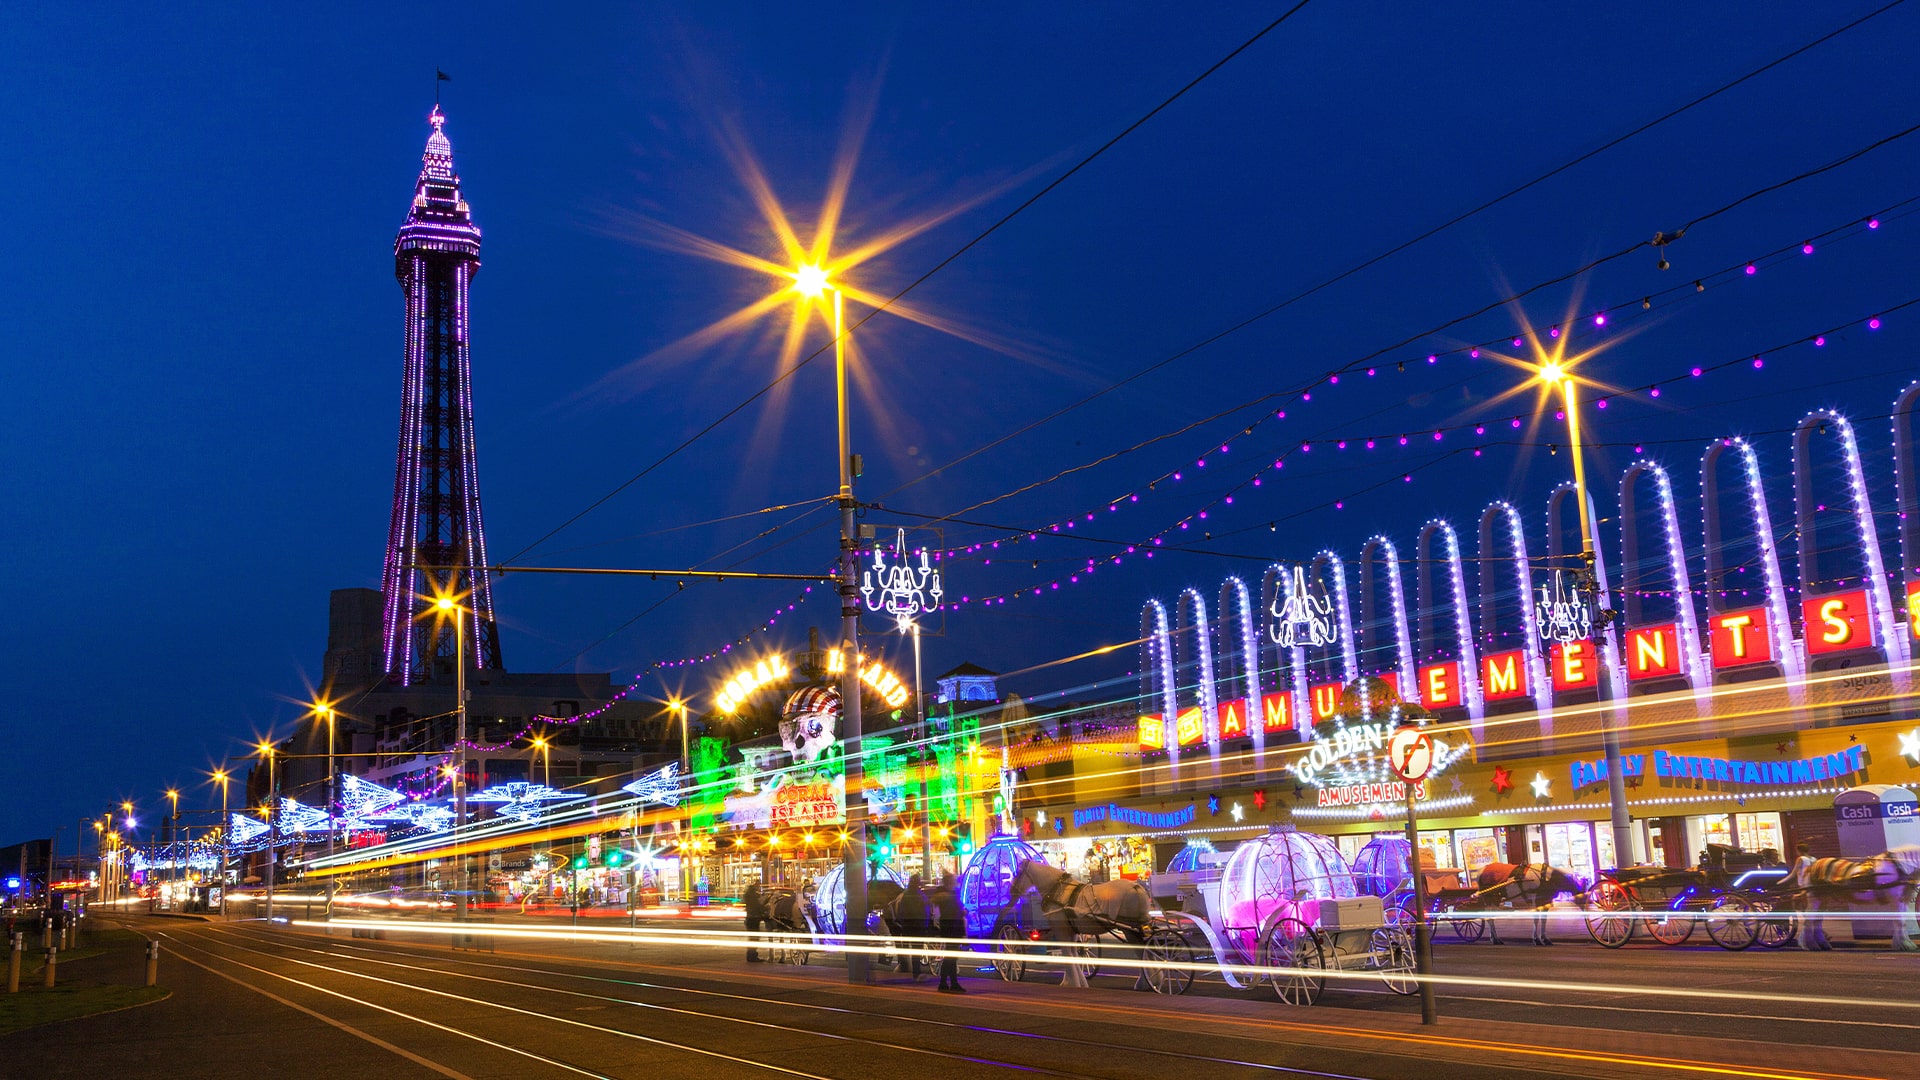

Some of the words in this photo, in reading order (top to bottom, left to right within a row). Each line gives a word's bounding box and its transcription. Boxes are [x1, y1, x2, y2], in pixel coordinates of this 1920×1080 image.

[1223, 599, 1851, 733] AMUEMENTS
[715, 655, 789, 713] CORAL
[1297, 722, 1383, 784] GOLDEN
[1570, 753, 1645, 791] FAMLY
[1653, 743, 1868, 785] ENTERTAINMENT
[776, 783, 834, 804] CORAL
[1317, 779, 1427, 808] AMUSEMENS
[769, 802, 840, 825] ISLAND
[1073, 805, 1106, 829] FAMILY
[1108, 802, 1197, 829] ENTERTAINMENT
[1841, 805, 1873, 819] Cash
[1886, 802, 1912, 816] Cash
